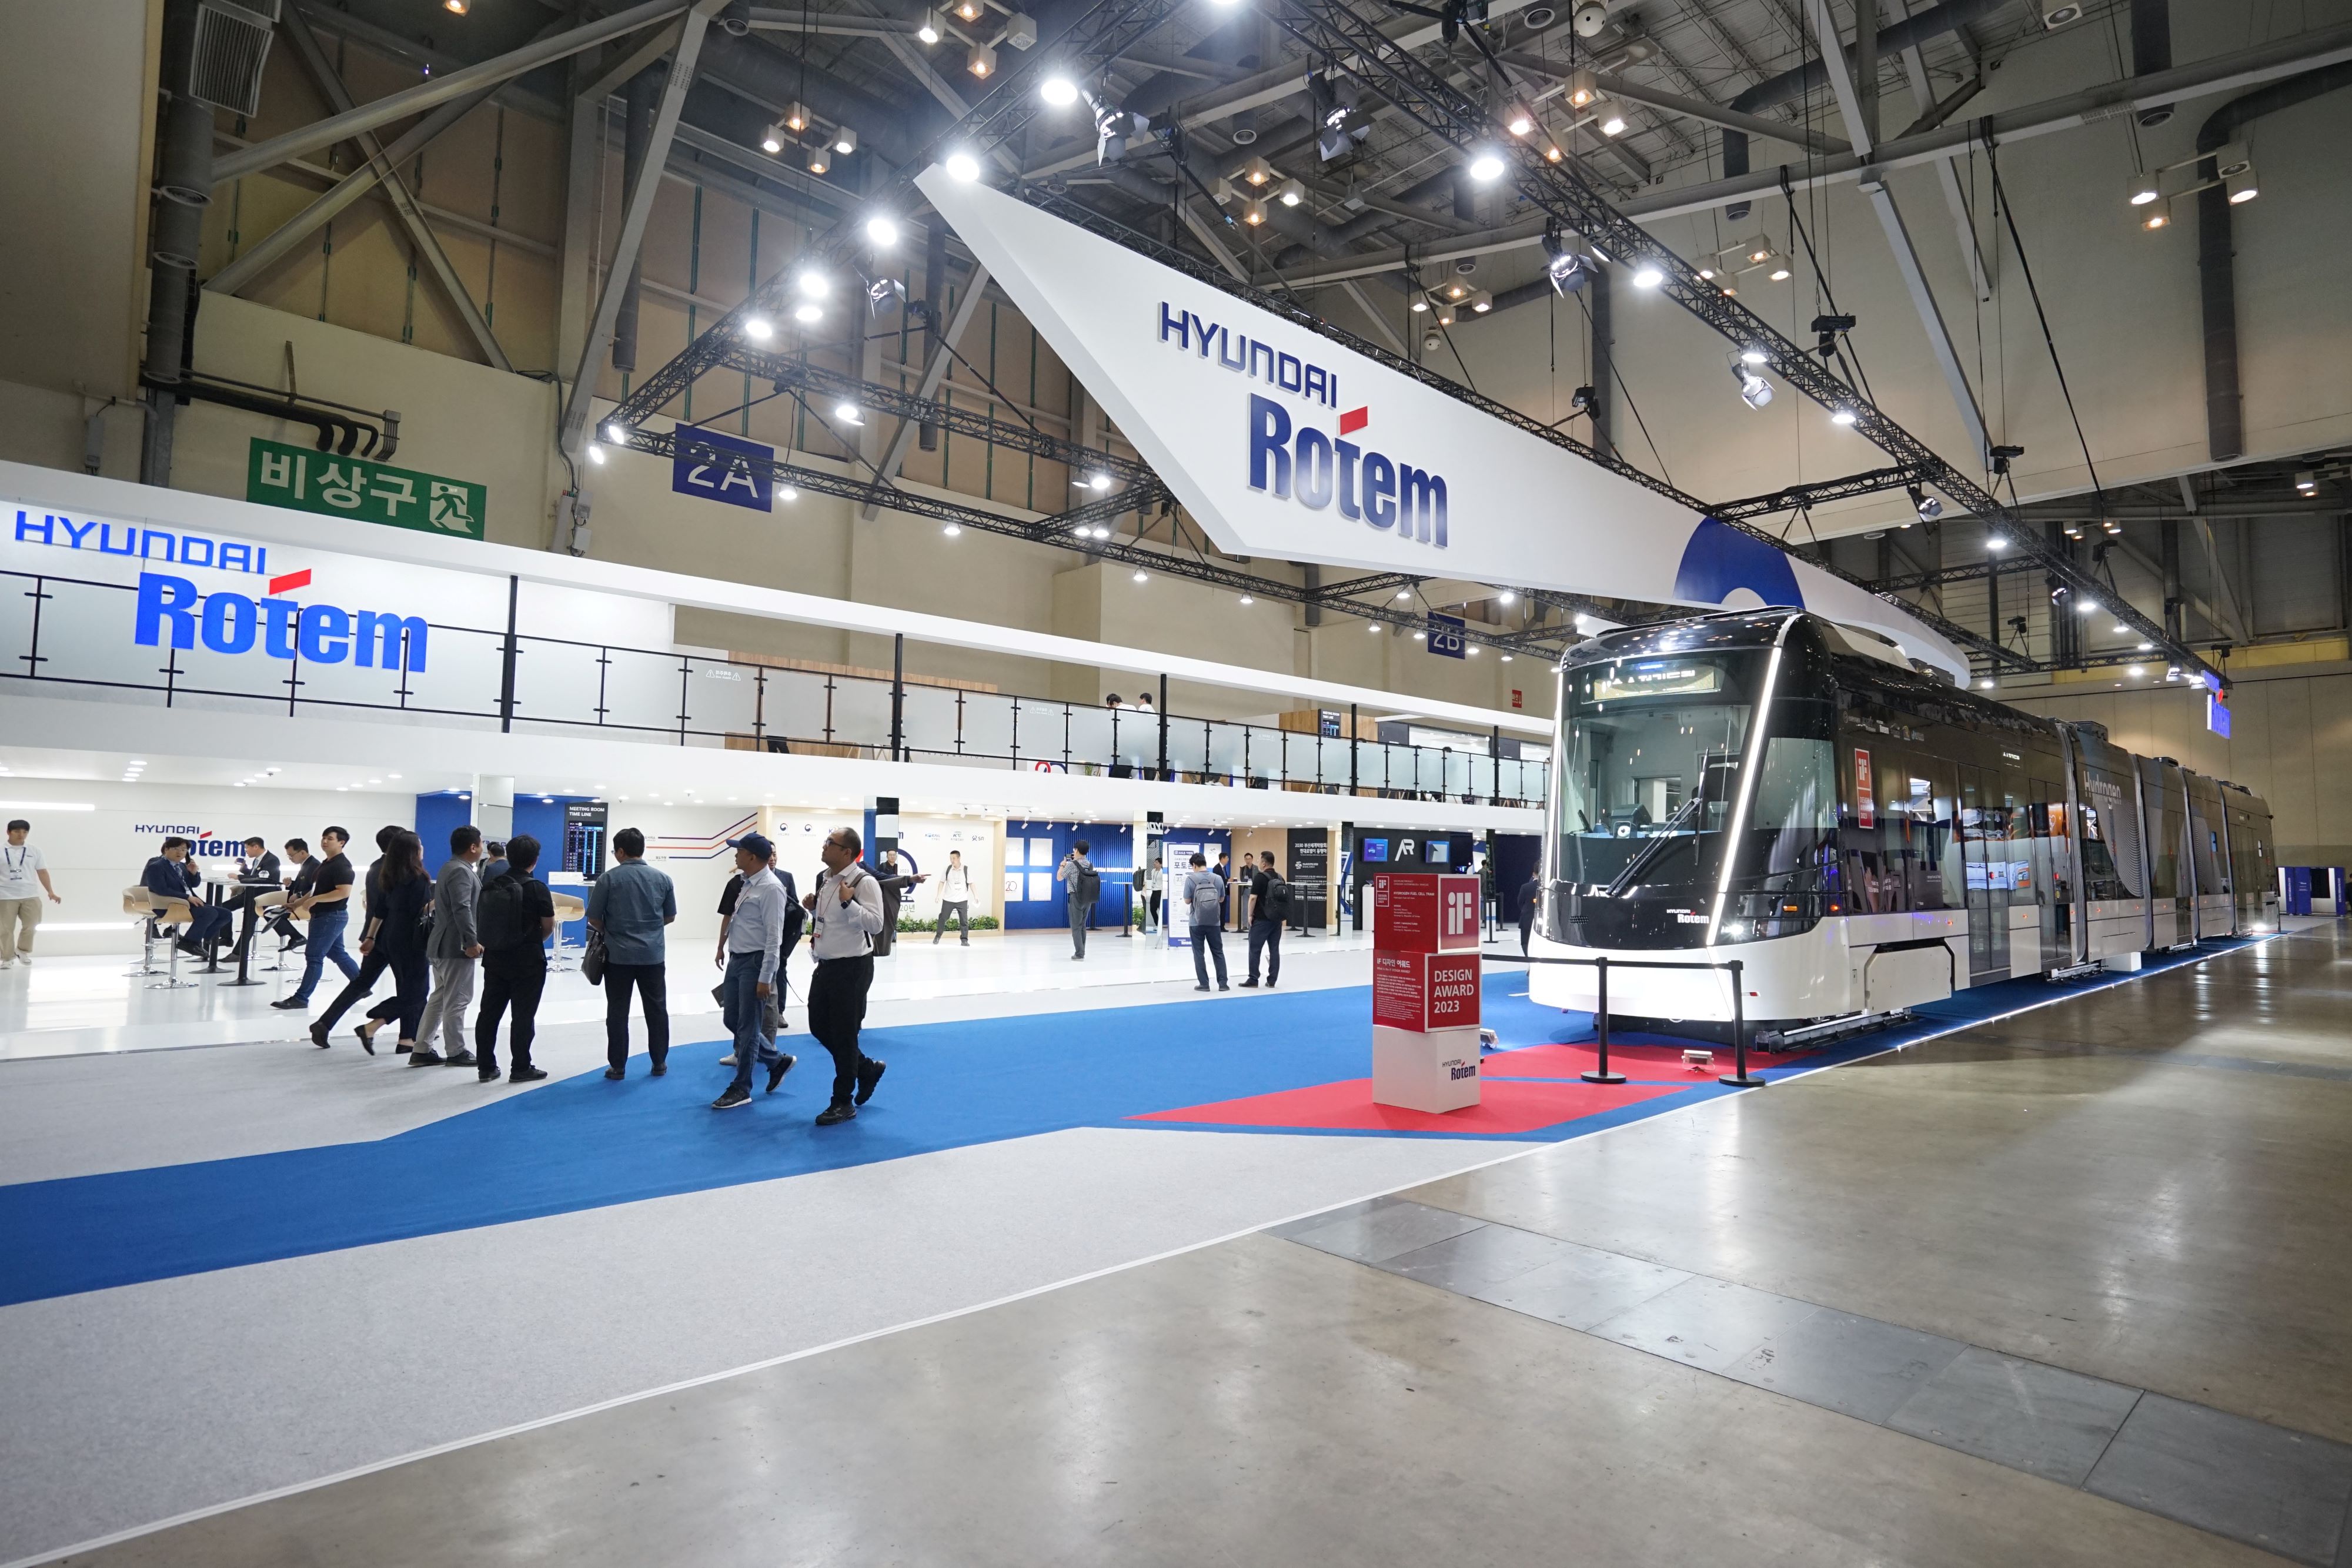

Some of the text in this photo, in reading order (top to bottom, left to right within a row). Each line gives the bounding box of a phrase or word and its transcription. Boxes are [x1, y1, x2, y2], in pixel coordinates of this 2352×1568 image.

[1159, 301, 1337, 409] HYUNDAI
[688, 442, 758, 498] 2A
[1248, 393, 1448, 548] Rotem
[260, 451, 417, 517] 비상구
[15, 510, 266, 575] HYUNDAI
[135, 569, 428, 673] Rotem
[2083, 771, 2122, 806] Hydrogen
[135, 824, 200, 834] HYUNDAI
[165, 836, 246, 857] otem
[1395, 838, 1415, 861] AR
[1448, 892, 1472, 934] iF
[1678, 912, 1709, 924] Rotem
[1382, 958, 1396, 967] 디자인
[1396, 959, 1411, 968] 어워드
[1434, 969, 1472, 982] DESIGN
[1434, 984, 1474, 998] AWARD
[1434, 1000, 1459, 1014] 2023
[1442, 1059, 1462, 1068] HYUNDAI
[1451, 1062, 1476, 1081] Rotem
